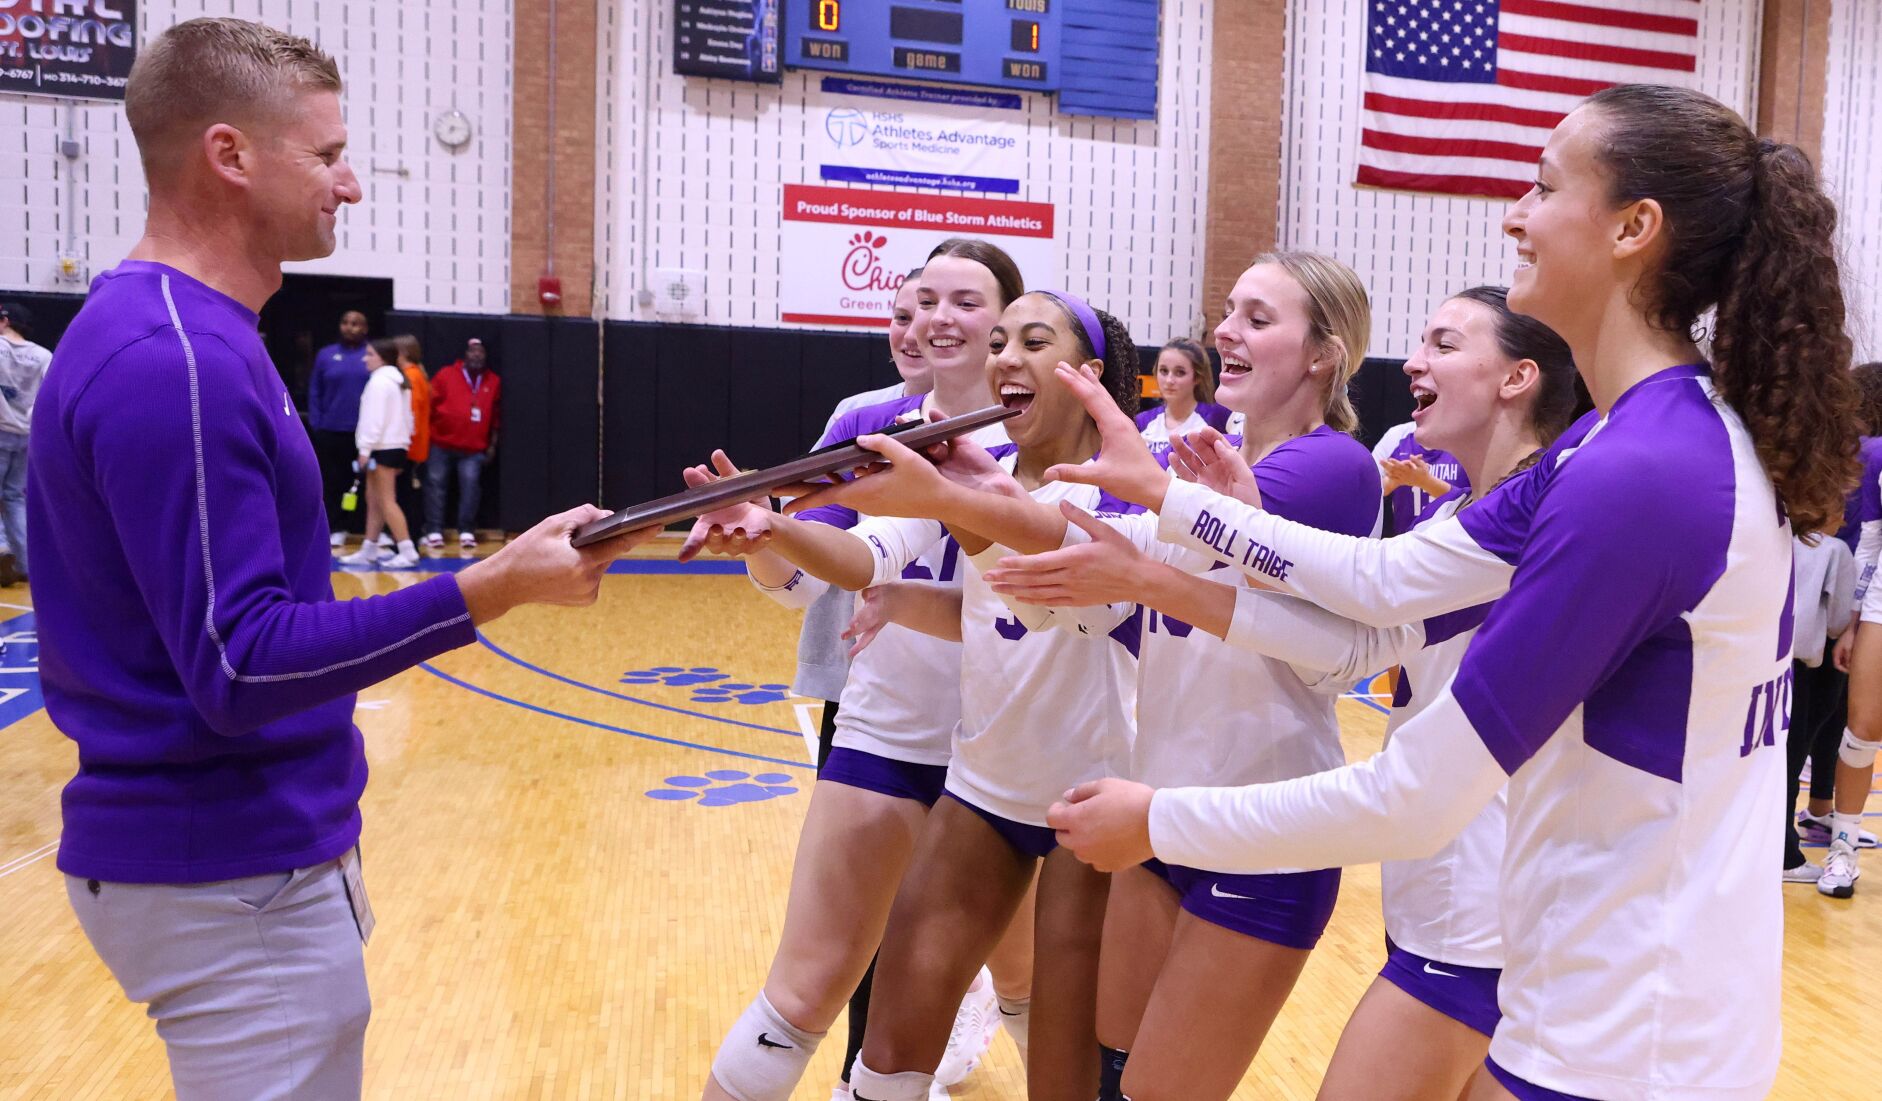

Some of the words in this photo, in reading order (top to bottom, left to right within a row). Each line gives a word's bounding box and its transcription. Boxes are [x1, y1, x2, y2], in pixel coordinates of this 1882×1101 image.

[820, 0, 839, 31] 0
[1031, 23, 1038, 50] 1
[28, 42, 93, 63] LOUIS
[809, 42, 841, 58] won
[906, 52, 946, 70] game
[1010, 63, 1040, 78] won
[873, 111, 904, 123] HSHS
[872, 124, 933, 141] Athletes
[937, 130, 1016, 149] Advantage
[873, 137, 909, 151] Sports
[912, 142, 961, 155] Medicine
[797, 200, 839, 216] Proud
[841, 204, 896, 219] Sponsor
[898, 208, 912, 219] of
[914, 209, 944, 222] Blue
[946, 211, 985, 226] Storm
[986, 214, 1042, 230] Athletics
[840, 297, 882, 310] Green
[1190, 509, 1239, 558] ROLL
[1241, 538, 1295, 583] TRIBE
